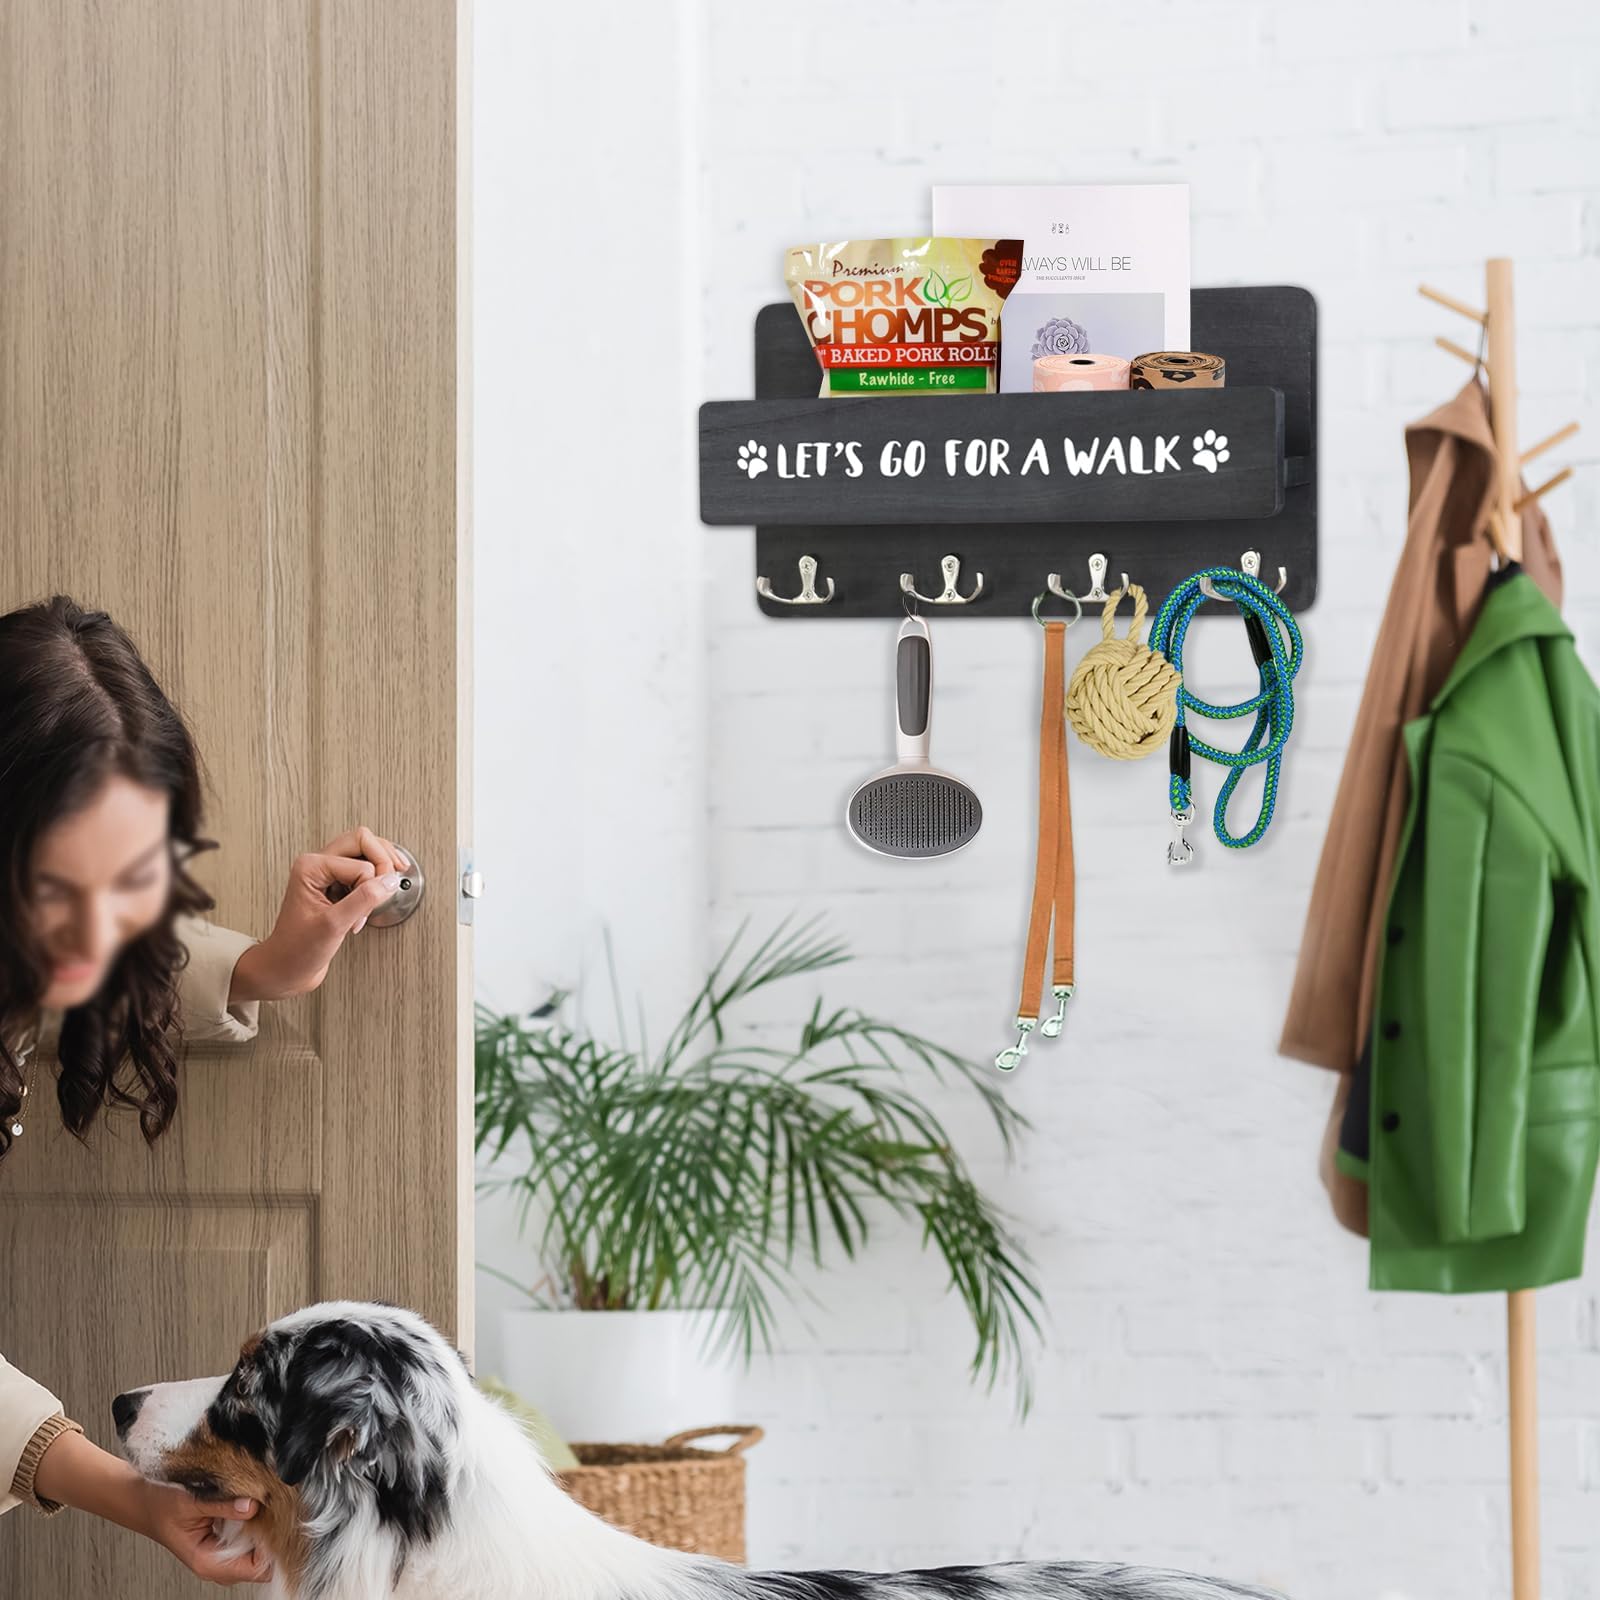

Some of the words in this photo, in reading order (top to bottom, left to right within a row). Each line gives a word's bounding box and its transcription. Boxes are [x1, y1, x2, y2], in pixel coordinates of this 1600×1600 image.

[832, 259, 904, 278] Premium
[1071, 256, 1107, 271] WILL
[1111, 256, 1131, 271] BE
[803, 277, 928, 310] PORK
[806, 307, 989, 345] CHOMPS
[830, 348, 892, 363] BAKED
[895, 347, 946, 363] PORK
[858, 371, 915, 387] Rawhide
[929, 371, 956, 385] Free
[777, 441, 864, 479] LET'S
[879, 439, 926, 478] GO
[944, 438, 1011, 477] FOR
[1020, 438, 1050, 476] A
[1063, 435, 1182, 477] WALK
